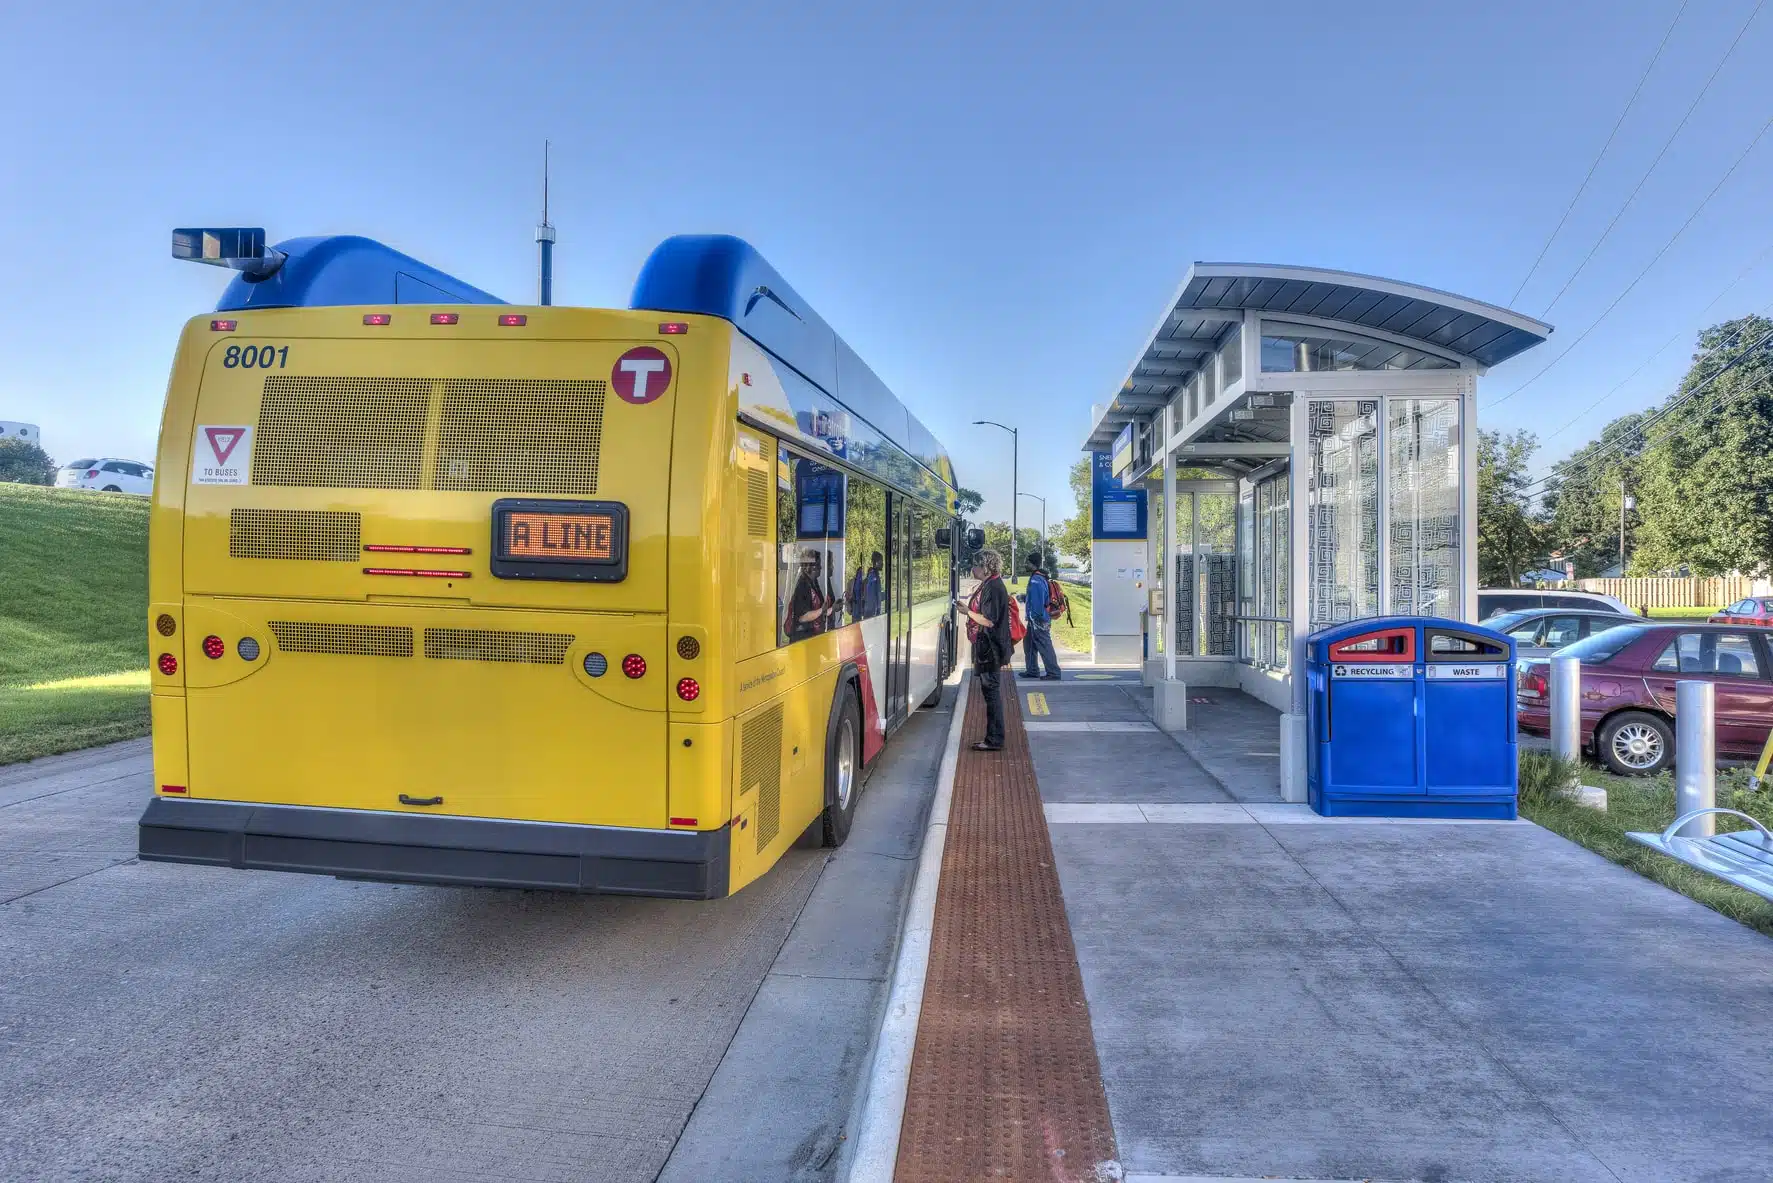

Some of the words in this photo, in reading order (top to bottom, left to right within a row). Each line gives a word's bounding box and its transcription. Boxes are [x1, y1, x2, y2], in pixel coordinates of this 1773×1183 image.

[223, 345, 289, 368] 8001
[620, 359, 665, 397] T
[215, 468, 238, 476] BUSES
[512, 521, 530, 547] A
[542, 520, 610, 551] LINE
[1452, 668, 1480, 676] WASTE
